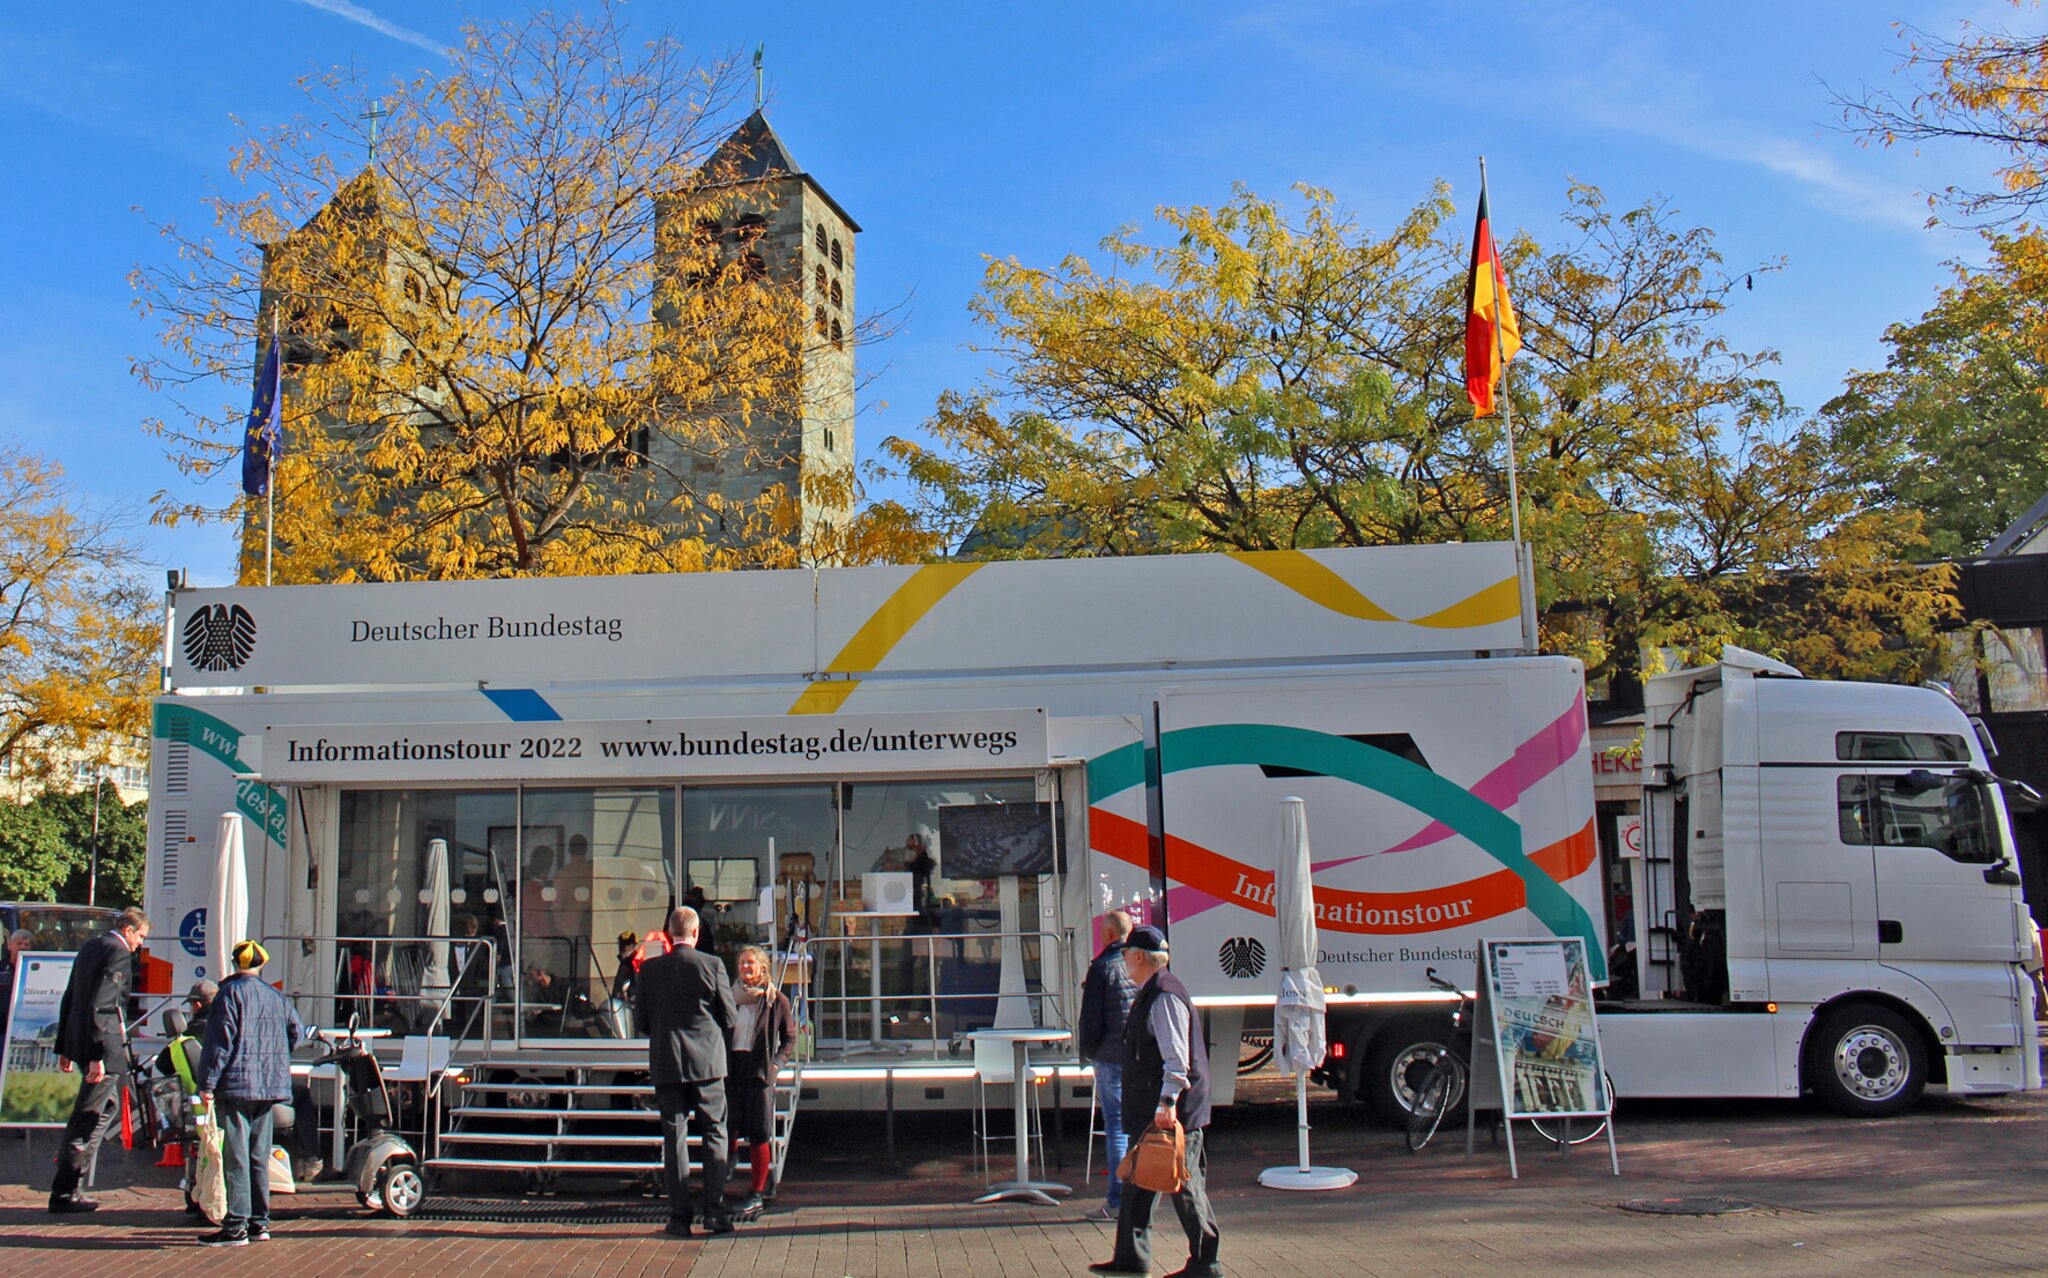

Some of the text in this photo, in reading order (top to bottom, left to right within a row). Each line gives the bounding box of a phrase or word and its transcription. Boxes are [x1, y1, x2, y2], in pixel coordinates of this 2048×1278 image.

[351, 616, 479, 643] Deutscher
[487, 613, 622, 642] Bundestag
[288, 728, 1017, 762] Informationstour 2022 www.bundestag.de/unterwegs
[1232, 872, 1473, 926] Infmationstour
[1316, 948, 1394, 964] Deutscher
